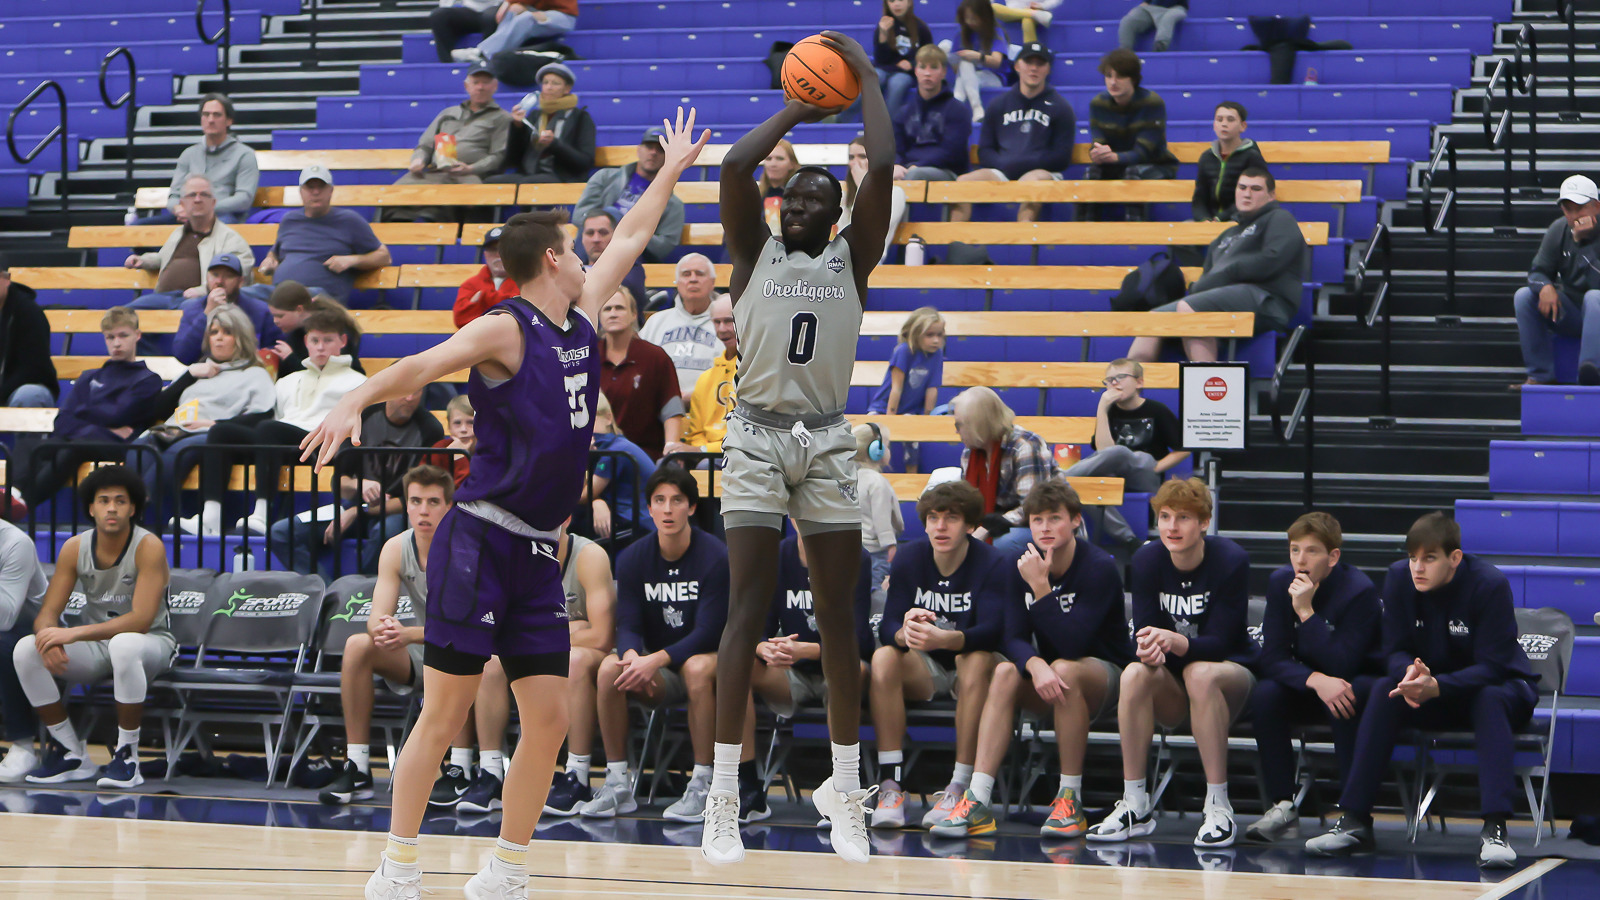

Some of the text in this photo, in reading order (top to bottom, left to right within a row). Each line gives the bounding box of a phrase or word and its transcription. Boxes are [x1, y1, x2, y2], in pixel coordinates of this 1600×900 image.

[796, 77, 827, 101] EVO
[1003, 109, 1050, 127] MINES
[763, 278, 846, 303] Orediggers
[674, 342, 695, 356] M
[787, 310, 819, 366] 0
[243, 597, 304, 606] SPORTS
[644, 581, 699, 602] MNES
[914, 587, 972, 613] MINES
